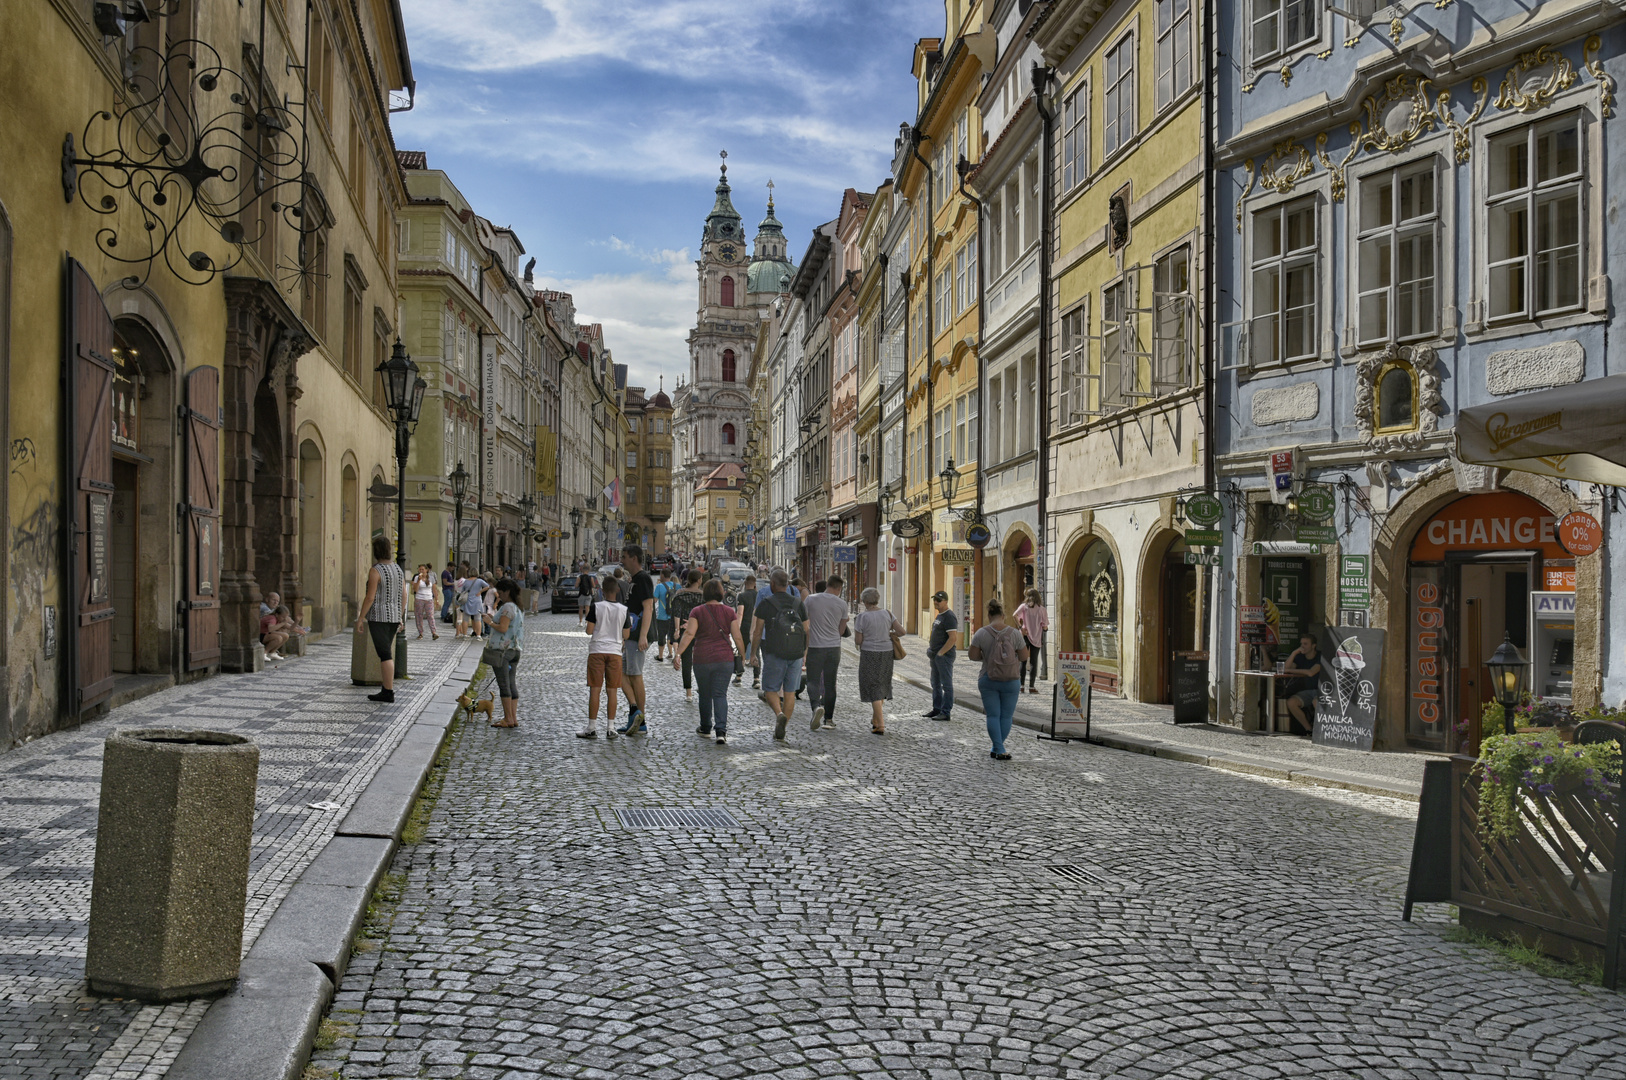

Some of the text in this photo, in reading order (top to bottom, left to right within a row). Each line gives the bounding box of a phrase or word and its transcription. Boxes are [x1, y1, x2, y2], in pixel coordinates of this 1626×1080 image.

[1485, 411, 1563, 454] Staropramen
[1276, 454, 1286, 463] 53
[1301, 489, 1320, 499] TOURIST
[1190, 496, 1208, 505] TOURIST
[1565, 514, 1596, 530] change
[1427, 516, 1556, 545] CHANGE
[1572, 527, 1588, 541] 0%
[1578, 543, 1593, 551] cash
[942, 549, 974, 561] CHANGE
[1198, 554, 1220, 565] WC
[1341, 577, 1368, 586] HOSTEL
[1538, 598, 1575, 610] ATM
[1413, 582, 1444, 724] change
[1360, 684, 1371, 695] XL
[1317, 713, 1353, 724] VANILKA
[1321, 724, 1372, 737] MANDARINKA
